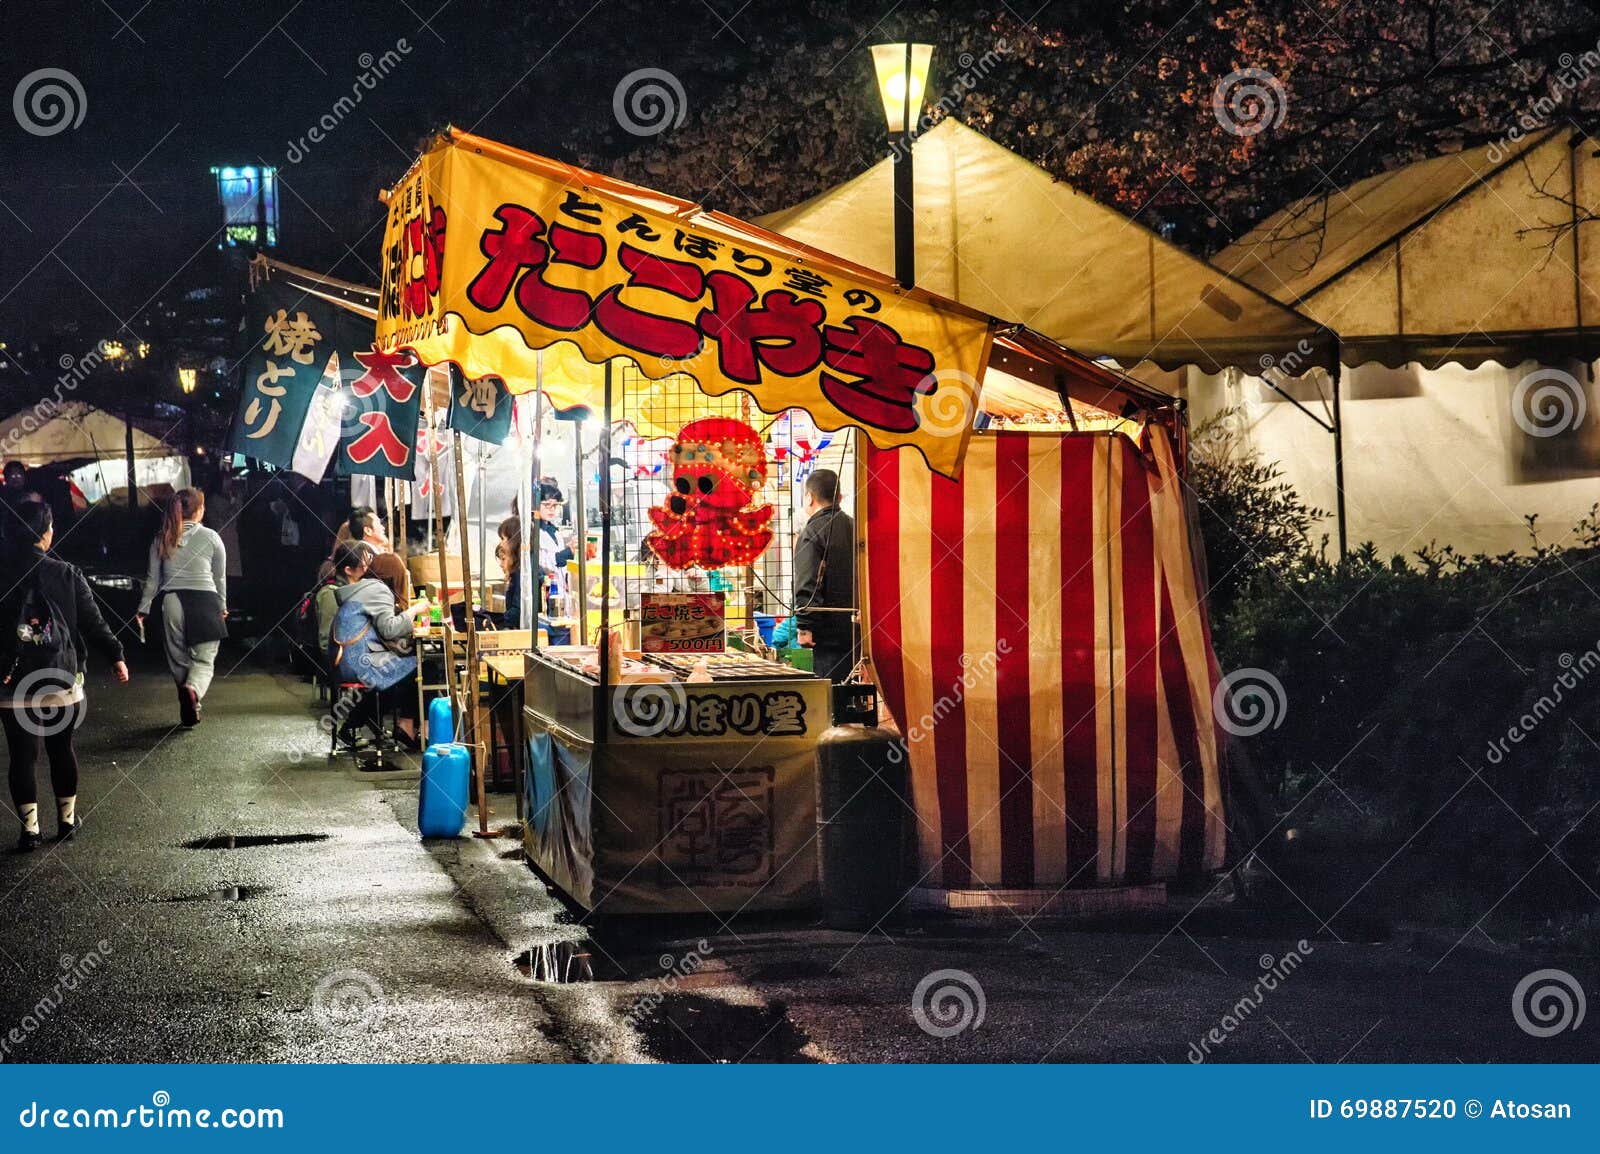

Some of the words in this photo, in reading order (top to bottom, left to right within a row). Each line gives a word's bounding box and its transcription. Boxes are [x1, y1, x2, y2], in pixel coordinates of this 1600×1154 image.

[244, 308, 322, 438] 焼とり
[466, 202, 937, 433] たこやき
[347, 343, 416, 467] 大入
[642, 604, 705, 621] たこ焼き
[670, 639, 722, 650] 500円
